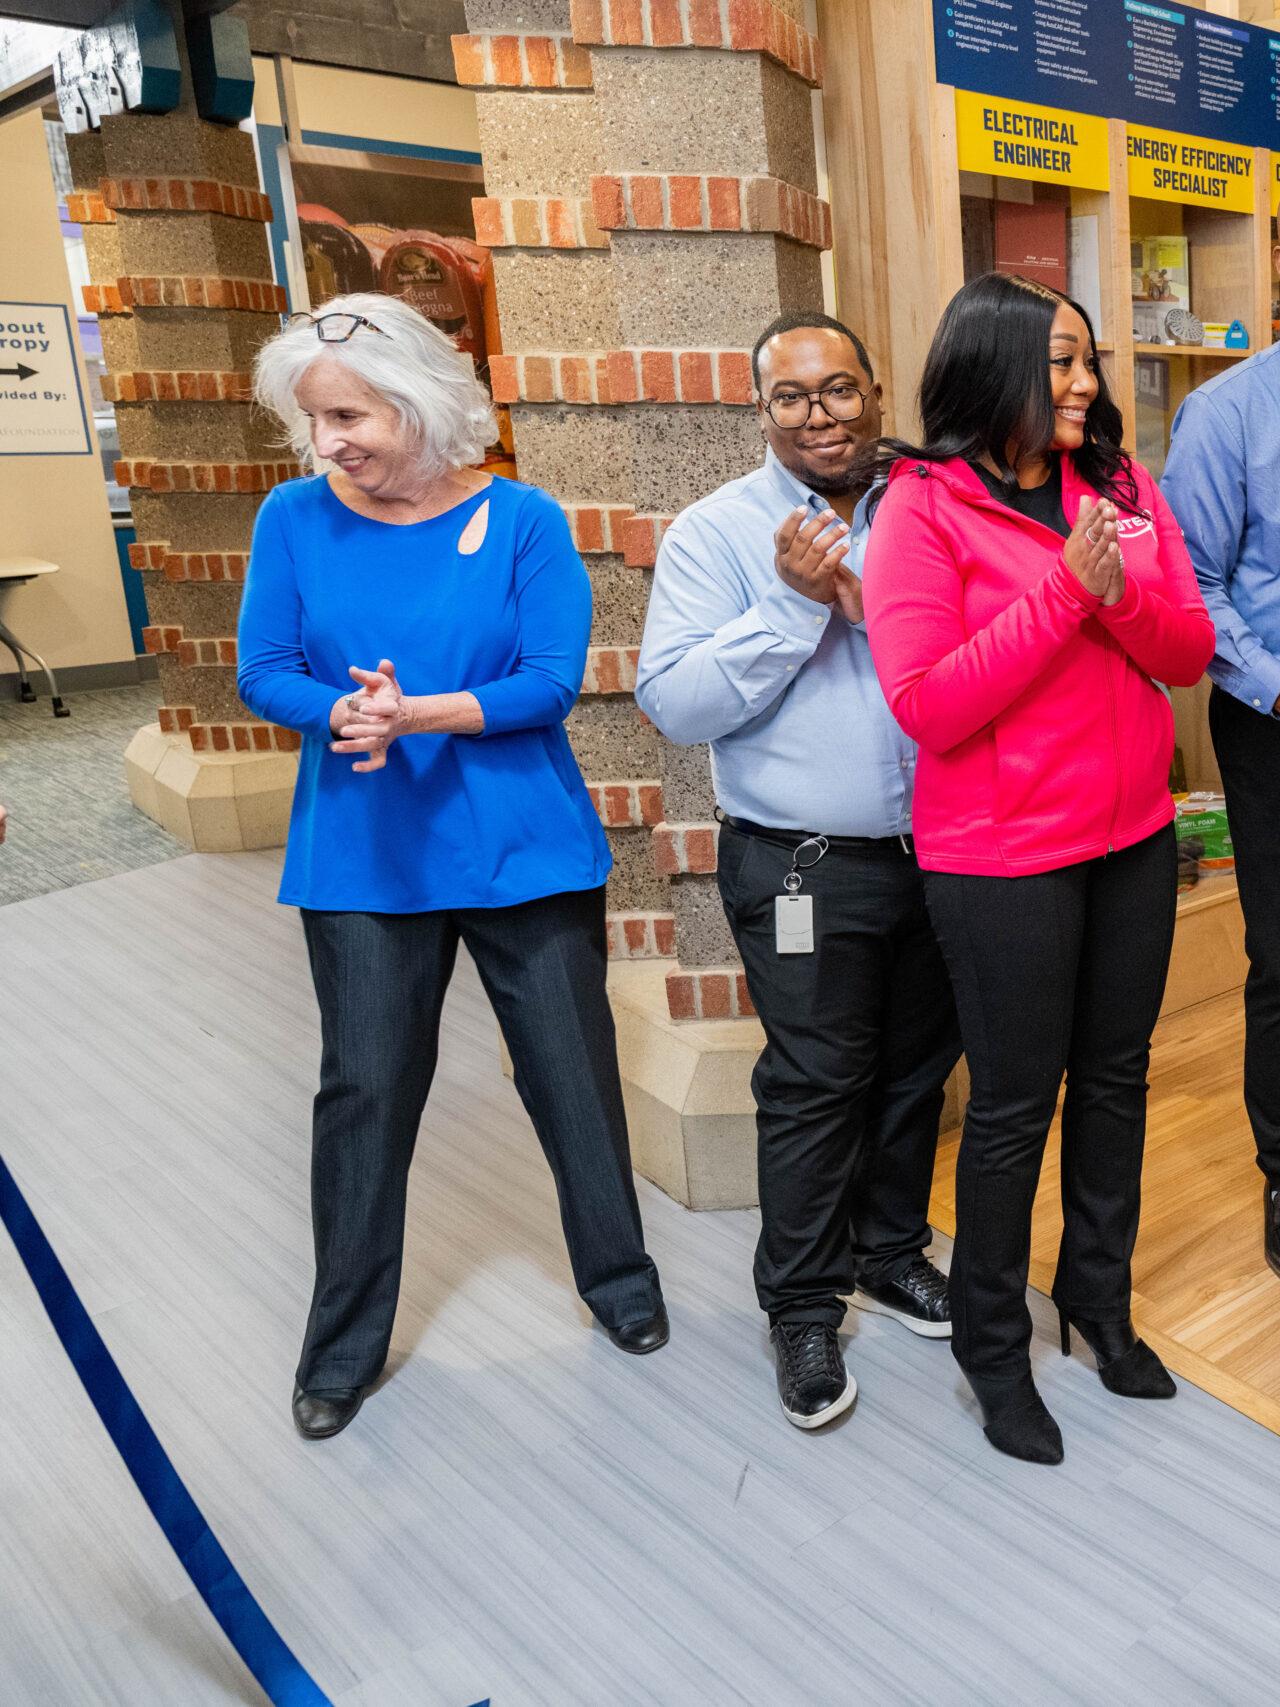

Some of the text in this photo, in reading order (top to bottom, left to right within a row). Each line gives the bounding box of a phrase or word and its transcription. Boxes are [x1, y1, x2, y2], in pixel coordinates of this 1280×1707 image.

[984, 109, 1078, 145] ELECTRICAL
[994, 141, 1071, 173] ENGINEER
[1126, 136, 1251, 177] ENERGY EFFICIENCY
[1153, 168, 1228, 198] SPECIALIST
[409, 289, 437, 301] Beef
[43, 391, 67, 401] By:
